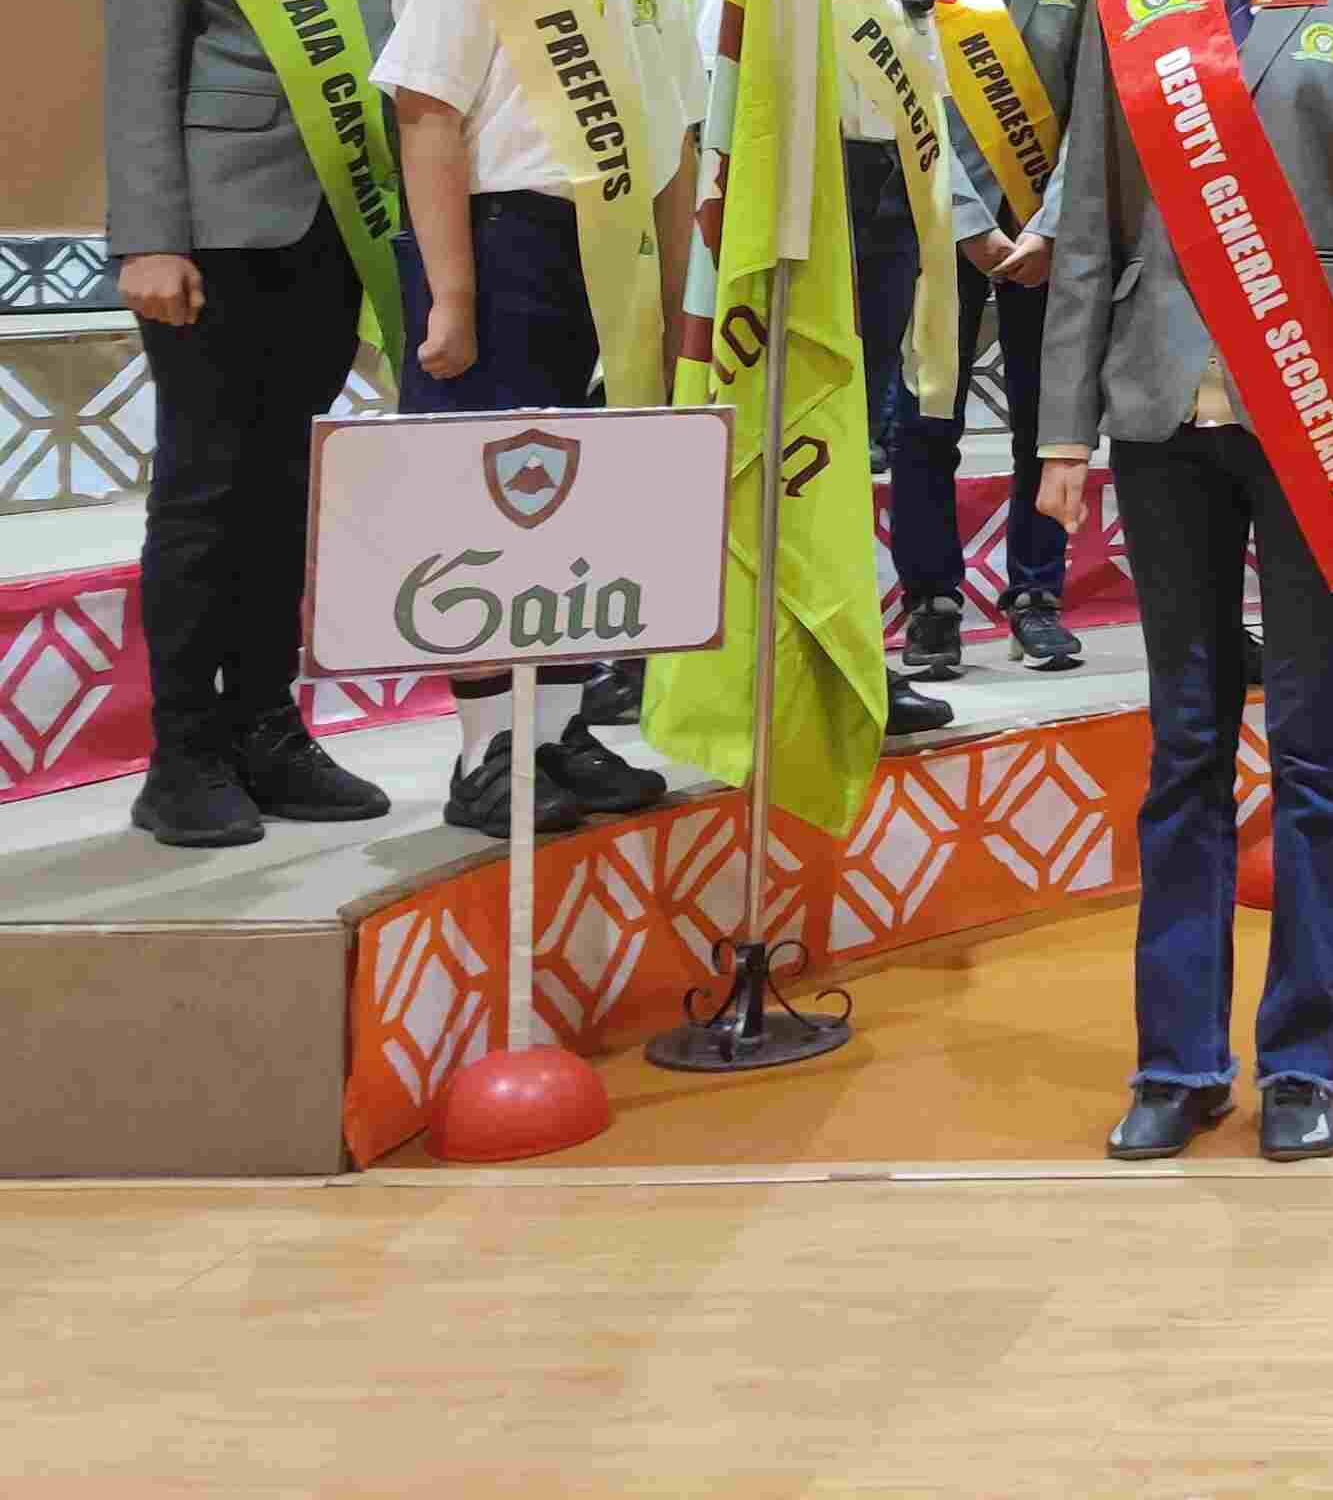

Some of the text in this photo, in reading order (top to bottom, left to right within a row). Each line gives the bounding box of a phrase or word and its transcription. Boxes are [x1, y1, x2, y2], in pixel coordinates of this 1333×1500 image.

[535, 9, 631, 202] PREFECTS
[851, 17, 940, 173] PREFECTS
[1155, 45, 1226, 170] DEPUTY
[1201, 175, 1290, 320] GENERAL
[394, 549, 647, 655] Gaia
